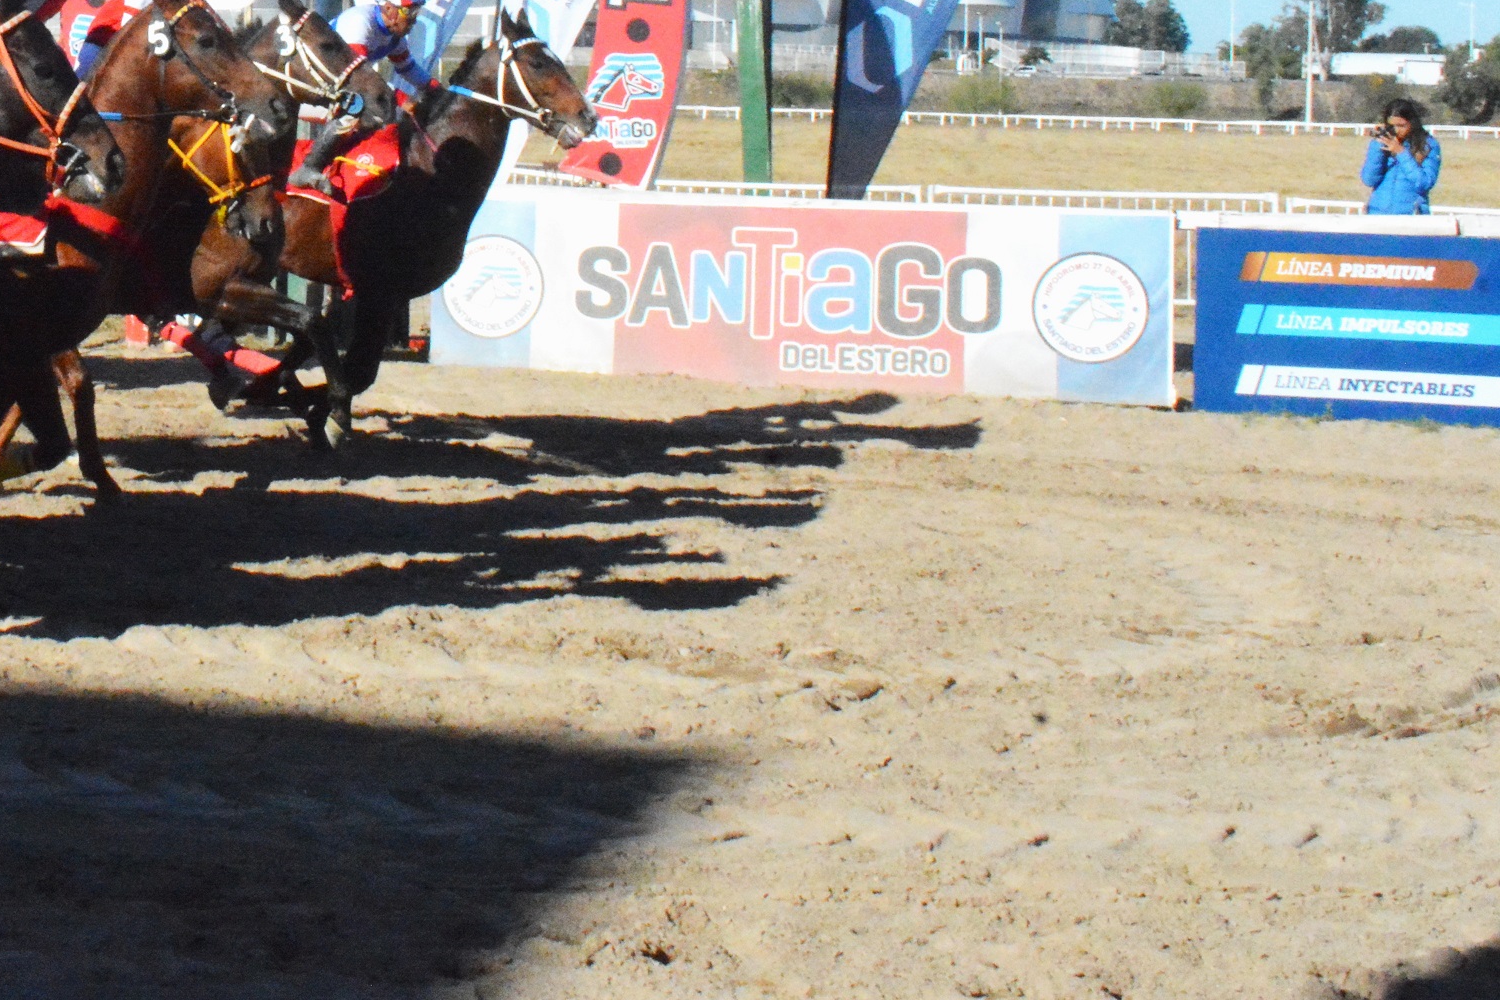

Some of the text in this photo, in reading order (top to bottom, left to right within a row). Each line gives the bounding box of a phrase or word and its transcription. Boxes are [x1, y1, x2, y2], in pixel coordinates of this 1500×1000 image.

[147, 20, 170, 56] 5
[275, 23, 296, 57] 3
[1044, 262, 1090, 297] HIPODROMO
[1104, 266, 1118, 277] DE
[1117, 275, 1136, 299] ABRIL
[1277, 257, 1436, 282] LÍNEA PREMIUM
[450, 296, 485, 330] SANTIAGO
[486, 322, 503, 331] DEL
[1276, 311, 1470, 338] LÍNEA IMPULSORES
[1043, 318, 1137, 355] SANTIAGO DEL ESTERO
[1275, 371, 1475, 399] LÍNEA INYECTABLES
